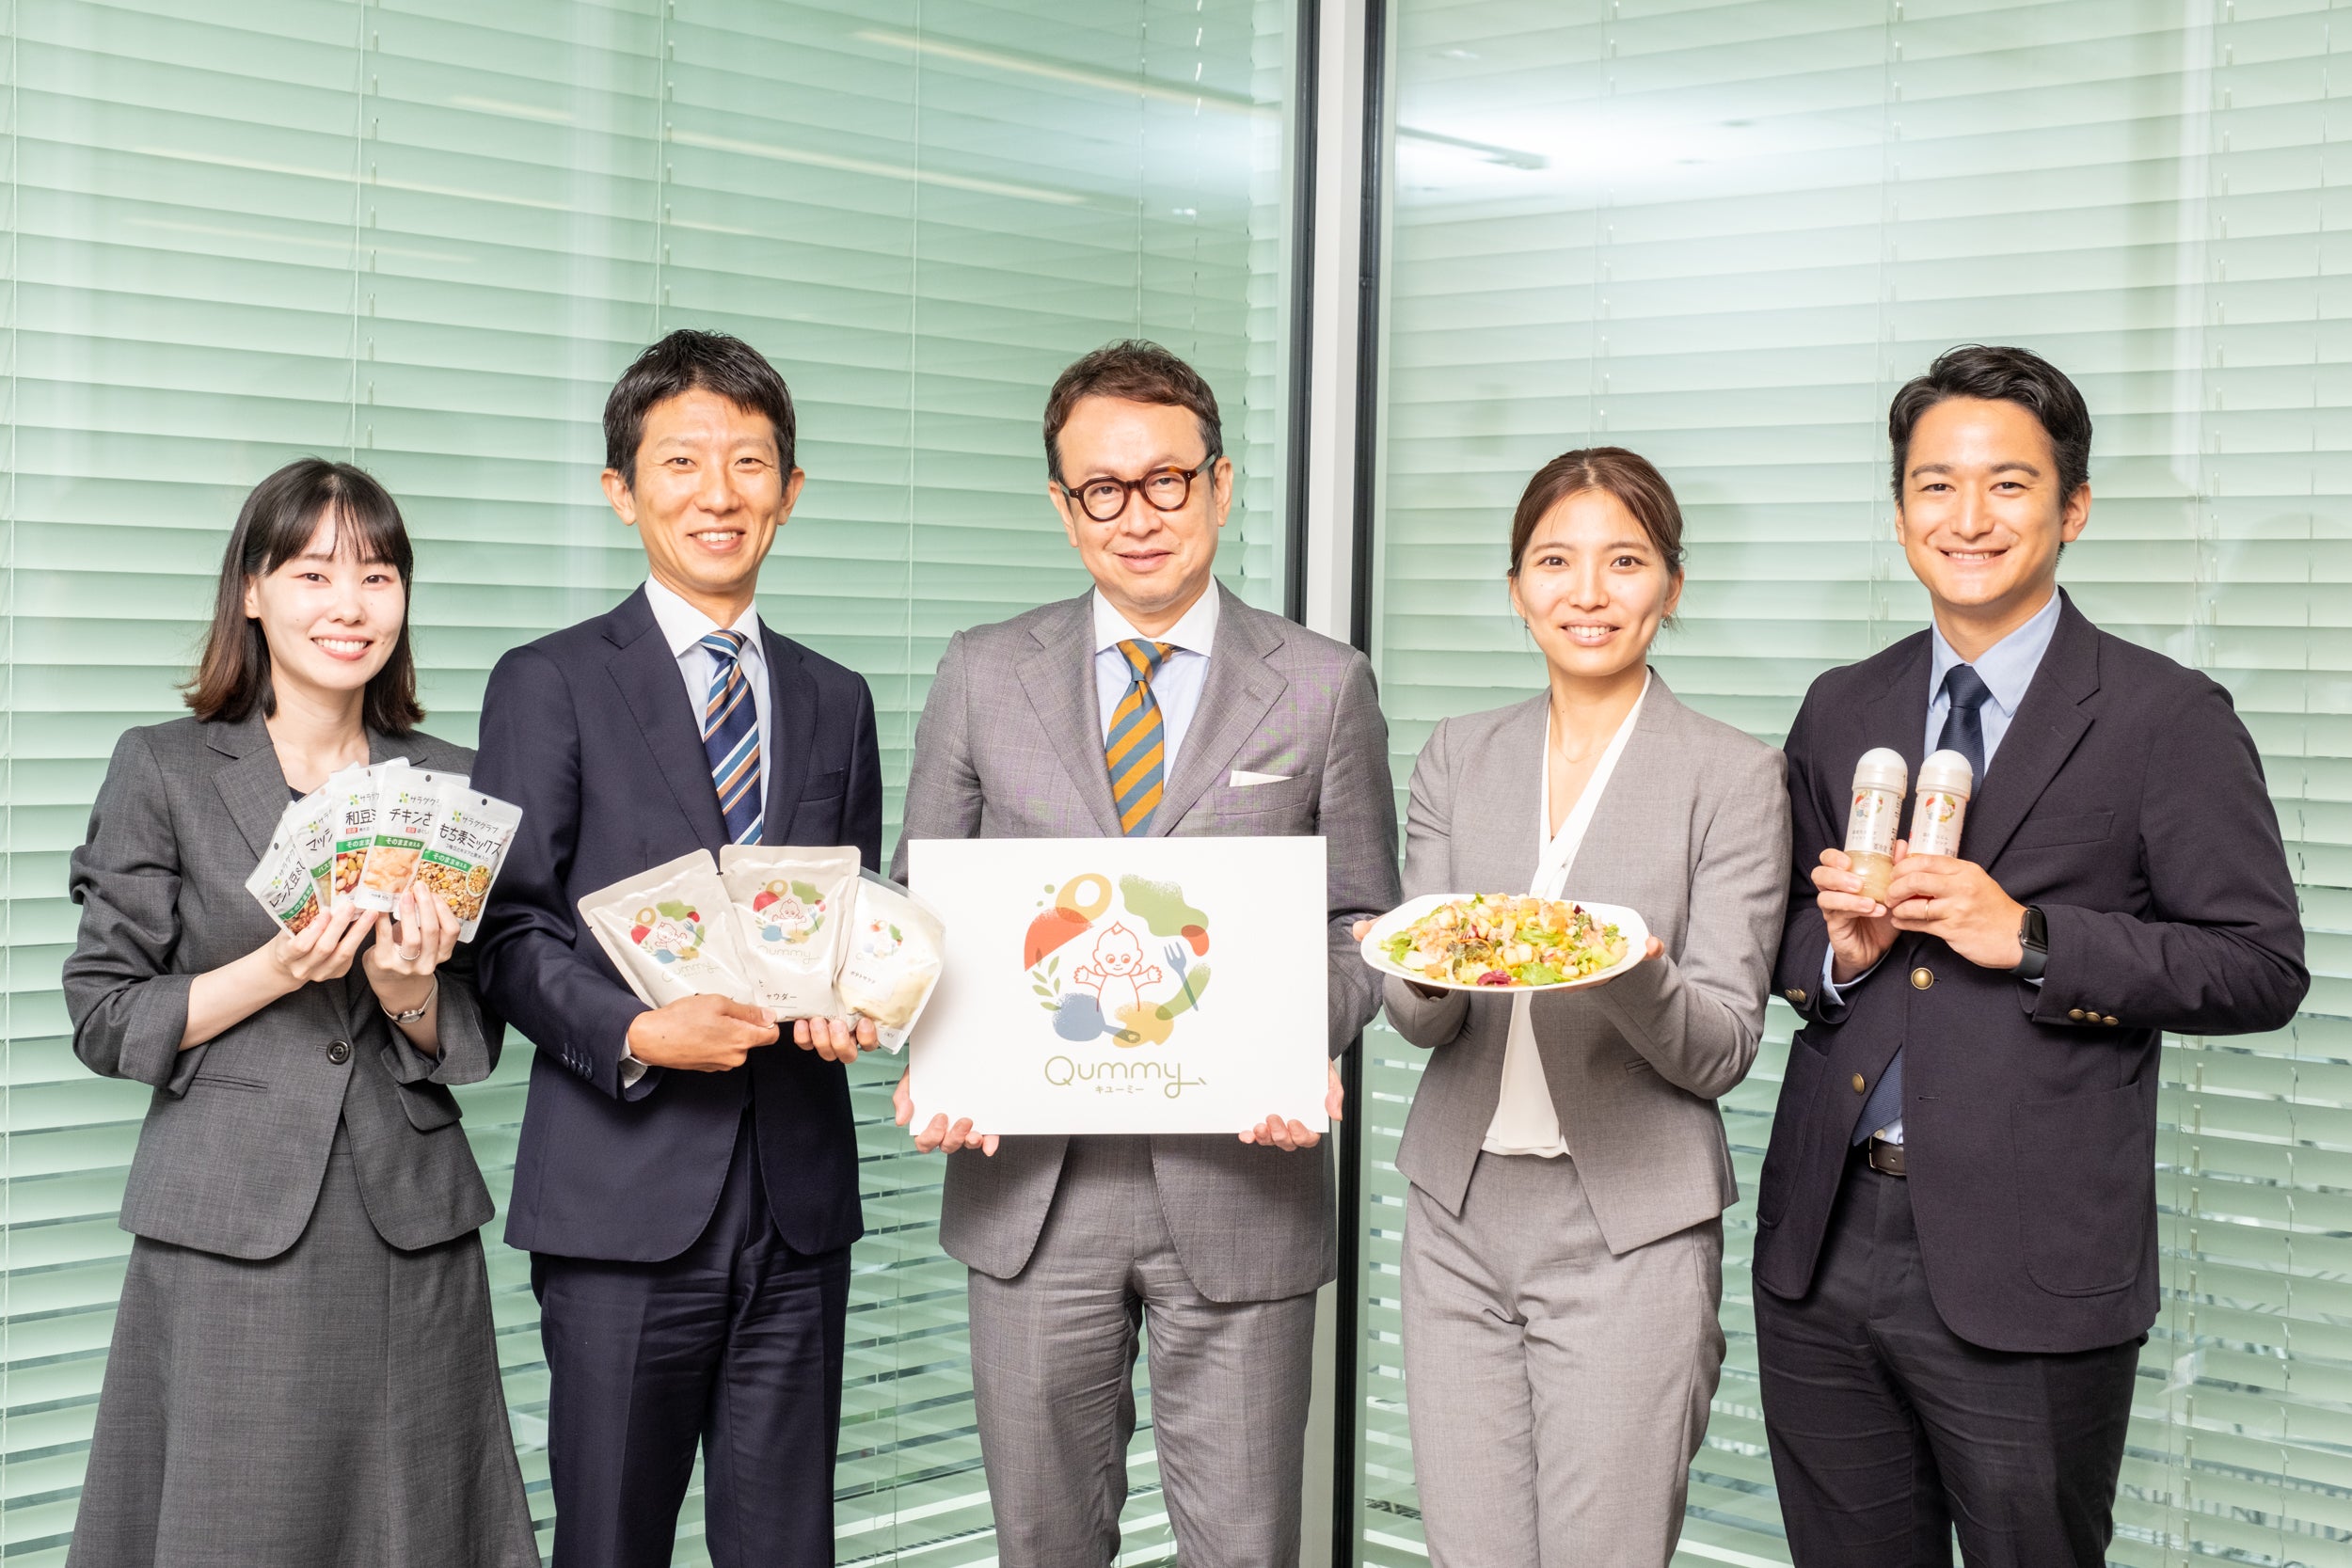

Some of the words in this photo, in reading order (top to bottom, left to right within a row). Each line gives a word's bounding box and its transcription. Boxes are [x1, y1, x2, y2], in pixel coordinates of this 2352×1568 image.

[389, 808, 433, 827] チキンさ
[439, 823, 502, 858] もち麦ミックス
[766, 992, 798, 1001] ャウダー
[1044, 1055, 1207, 1099] Qummy
[1094, 1085, 1145, 1095] キユーミー
